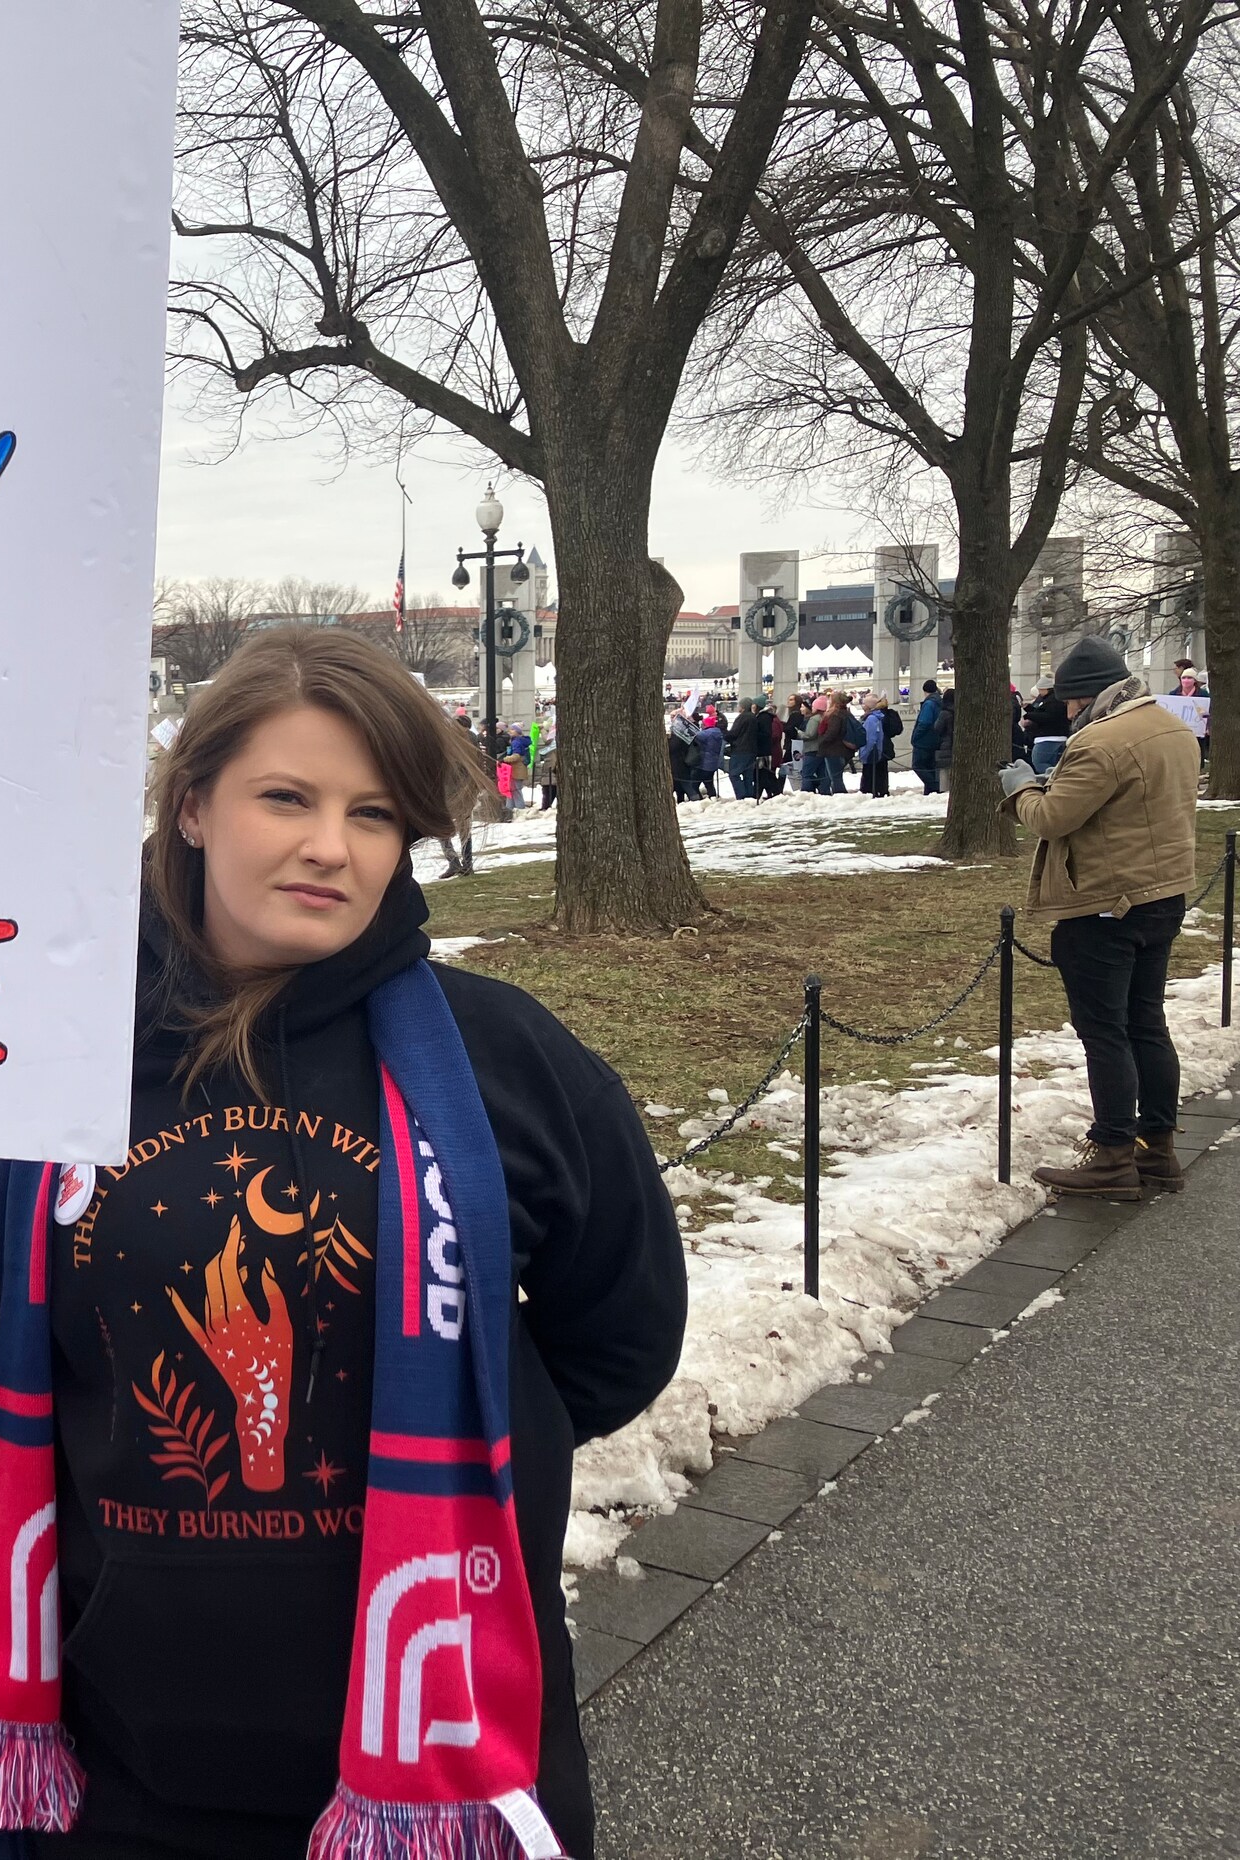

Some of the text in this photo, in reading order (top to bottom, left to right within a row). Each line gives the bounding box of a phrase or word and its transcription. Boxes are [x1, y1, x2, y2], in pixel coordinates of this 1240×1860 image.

[223, 1105, 324, 1139] BURN
[98, 1497, 169, 1536] THEY
[178, 1509, 305, 1539] BURNED
